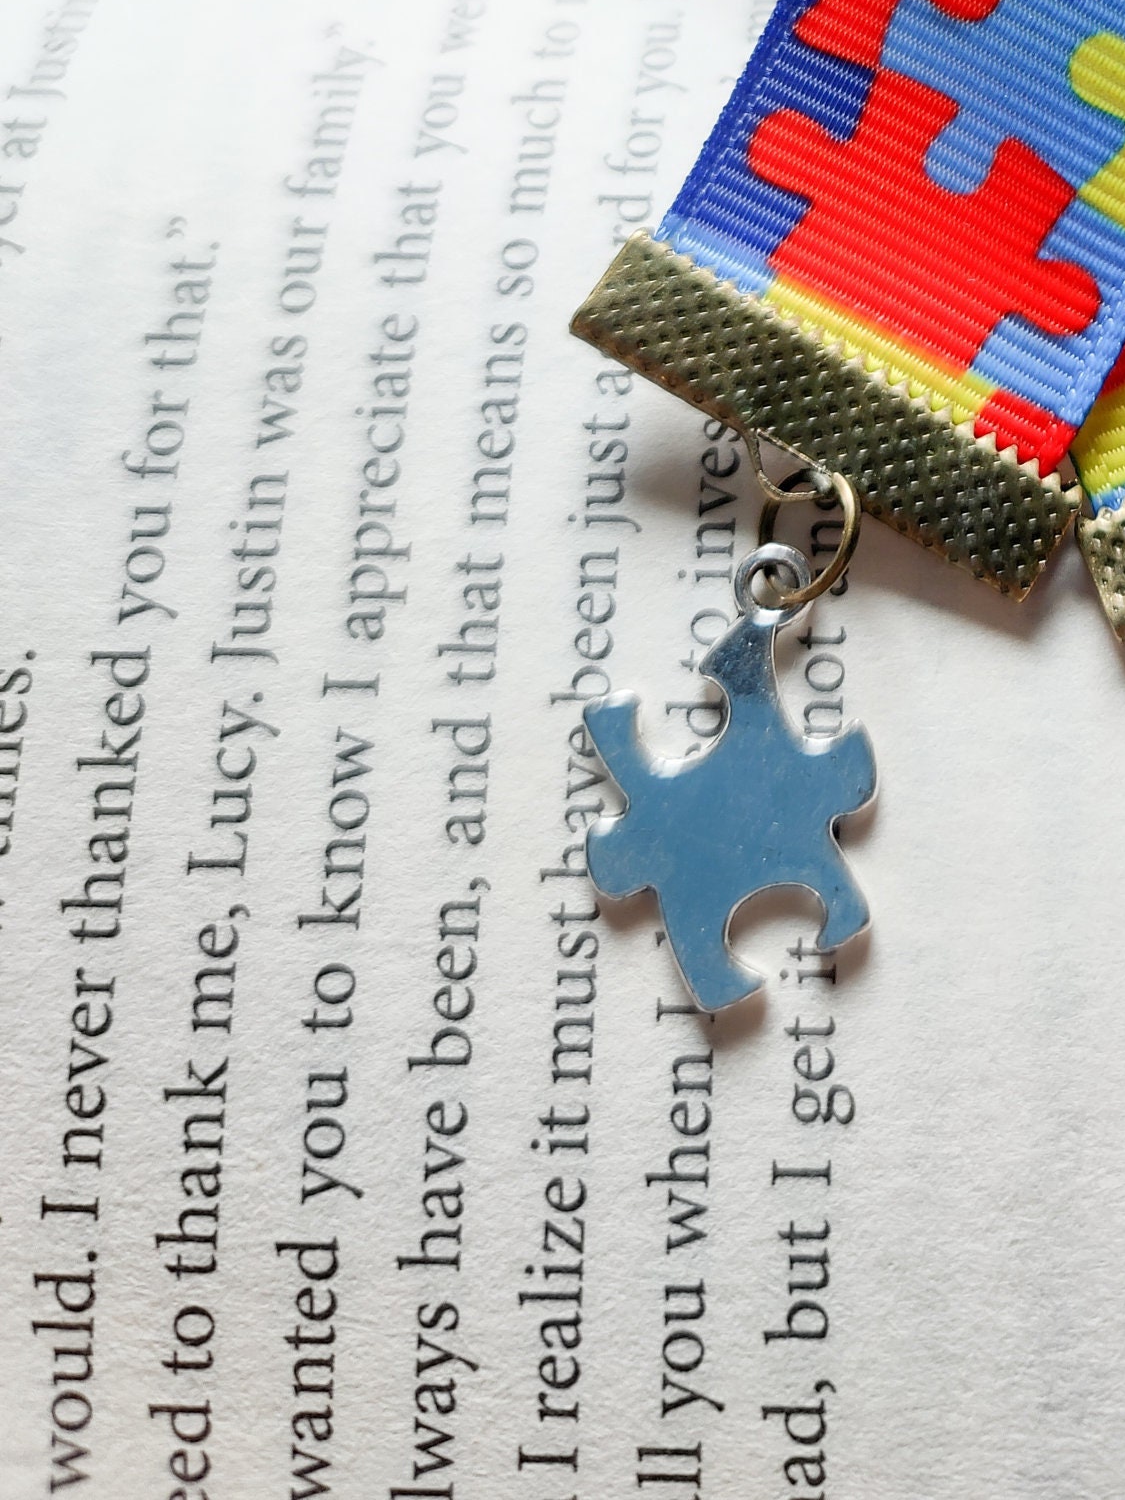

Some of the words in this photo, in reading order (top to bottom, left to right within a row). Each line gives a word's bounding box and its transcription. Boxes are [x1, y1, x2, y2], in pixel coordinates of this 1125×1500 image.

[532, 20, 578, 60] to
[634, 12, 688, 97] you.
[412, 75, 468, 158] you
[507, 80, 565, 215] much
[603, 109, 664, 176] for
[278, 217, 327, 315] our
[371, 184, 441, 288] that
[493, 238, 539, 298] so
[120, 391, 188, 479] for
[254, 336, 306, 449] was
[469, 324, 525, 525] means
[344, 315, 417, 642] appreciate
[568, 415, 641, 533] just
[117, 506, 177, 625] you
[209, 474, 287, 663] Justin
[436, 554, 504, 686] that
[550, 547, 618, 706] been
[321, 675, 379, 697] I
[796, 626, 848, 736] not
[60, 648, 149, 944] thanked
[186, 693, 279, 876] Lucy.
[296, 729, 373, 930] know
[431, 717, 491, 847] and
[191, 905, 250, 1034] me,
[301, 964, 356, 1033] to
[407, 879, 490, 1072] been,
[548, 903, 601, 1085] must
[62, 968, 115, 1169] never
[539, 1106, 590, 1155] it
[785, 1017, 855, 1126] get
[154, 1058, 228, 1280] thank
[301, 1067, 364, 1204] you
[395, 1101, 468, 1271] have
[647, 1048, 714, 1250] when
[771, 1161, 831, 1186] I
[41, 1196, 99, 1221] I
[162, 1306, 215, 1375] to
[518, 1177, 587, 1422] realize
[763, 1221, 830, 1345] but
[31, 1251, 98, 1493] would.
[275, 1238, 339, 1500] wanted
[661, 1280, 725, 1418] you
[518, 1446, 578, 1472] I
